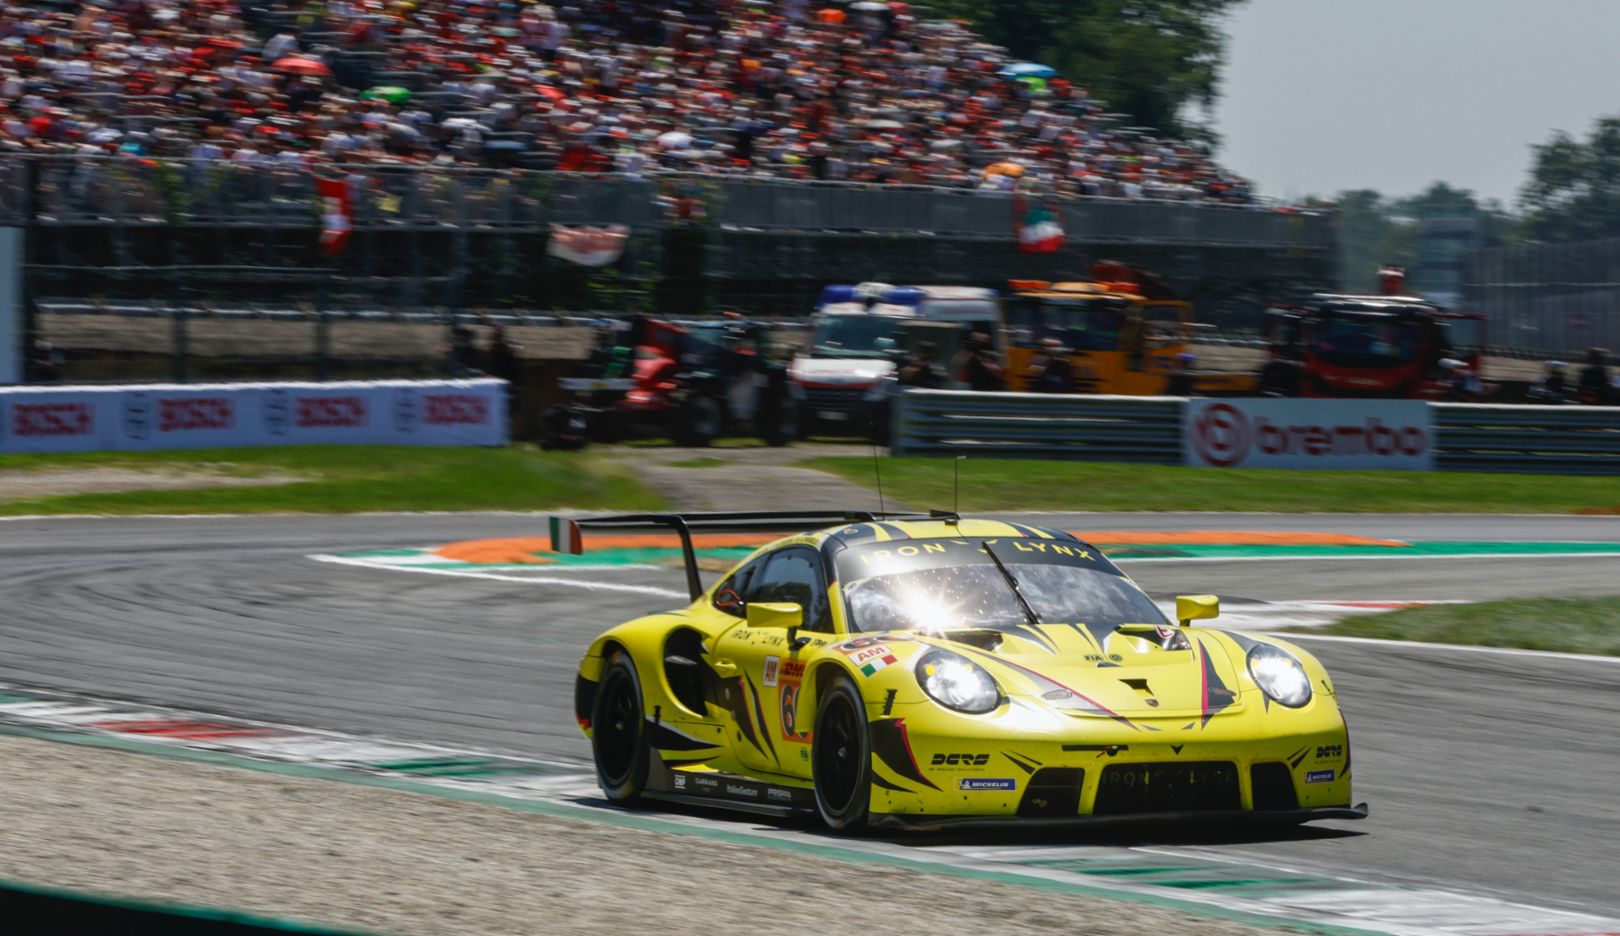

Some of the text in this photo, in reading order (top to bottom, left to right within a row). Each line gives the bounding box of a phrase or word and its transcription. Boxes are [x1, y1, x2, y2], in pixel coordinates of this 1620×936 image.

[1254, 416, 1428, 456] brembo
[859, 540, 1097, 565] IRON LYNX
[858, 647, 886, 662] AM
[971, 780, 1010, 789] MICHELIN
